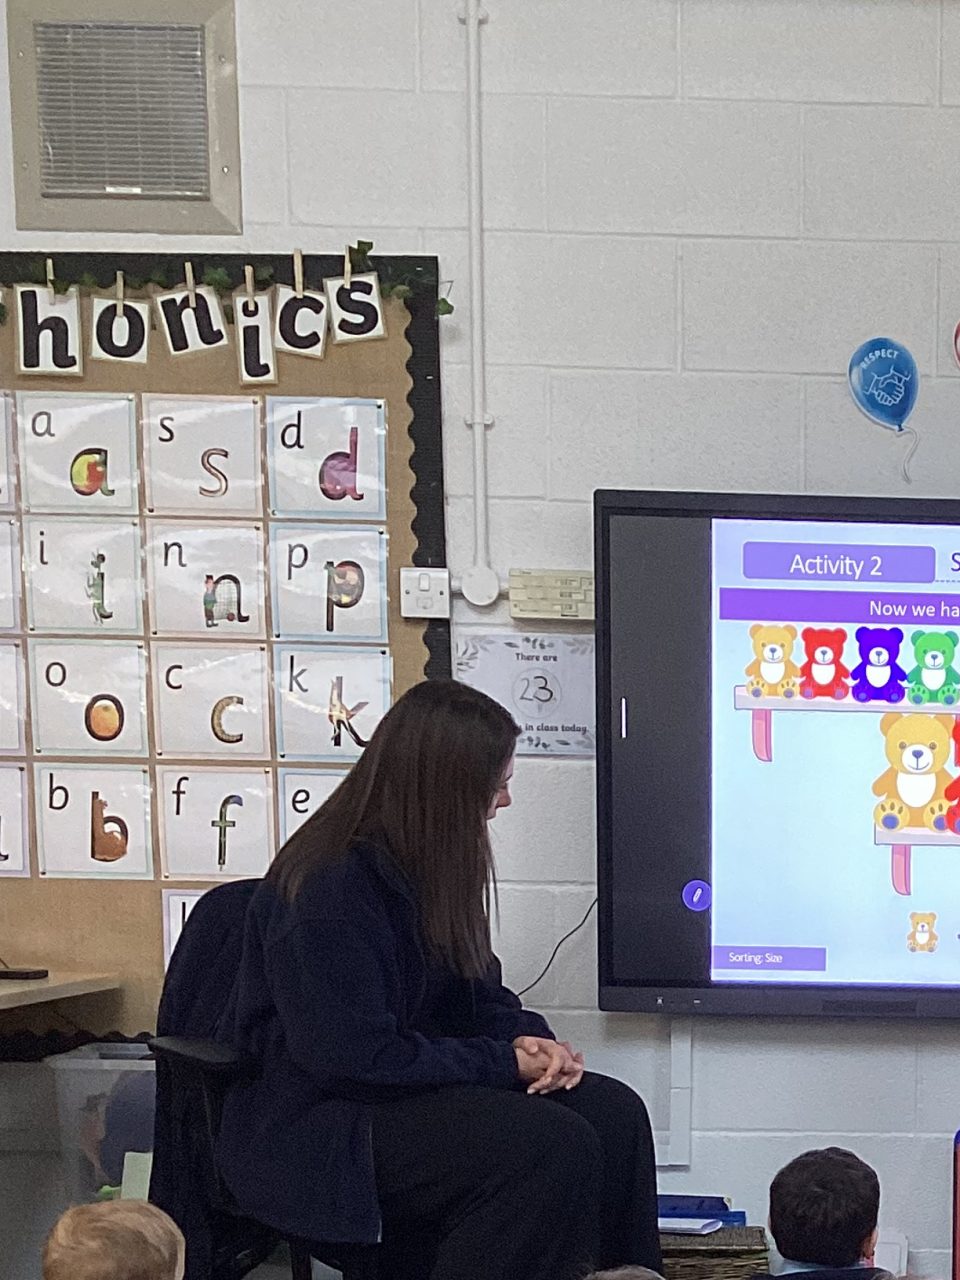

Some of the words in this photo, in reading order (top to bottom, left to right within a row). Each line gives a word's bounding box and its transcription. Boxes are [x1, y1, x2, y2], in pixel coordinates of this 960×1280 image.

[860, 348, 899, 369] RESPECT
[31, 411, 56, 437] a
[158, 416, 175, 442] s
[280, 410, 304, 449] d
[38, 531, 49, 565] i
[164, 541, 187, 567] n
[287, 542, 309, 580] p
[789, 553, 864, 580] Activity
[870, 556, 882, 576] 2
[870, 600, 907, 616] Now
[912, 604, 935, 617] we
[515, 652, 540, 662] There
[543, 654, 558, 662] are
[45, 662, 67, 686] o
[165, 664, 183, 689] c
[289, 655, 309, 692] k
[519, 675, 554, 703] 23
[525, 723, 534, 732] in
[536, 723, 559, 732] class
[561, 723, 589, 735] today.
[49, 773, 70, 810] b
[172, 776, 190, 815] f
[291, 788, 311, 813] e
[729, 952, 763, 966] Sorting:
[765, 953, 783, 964] Size
